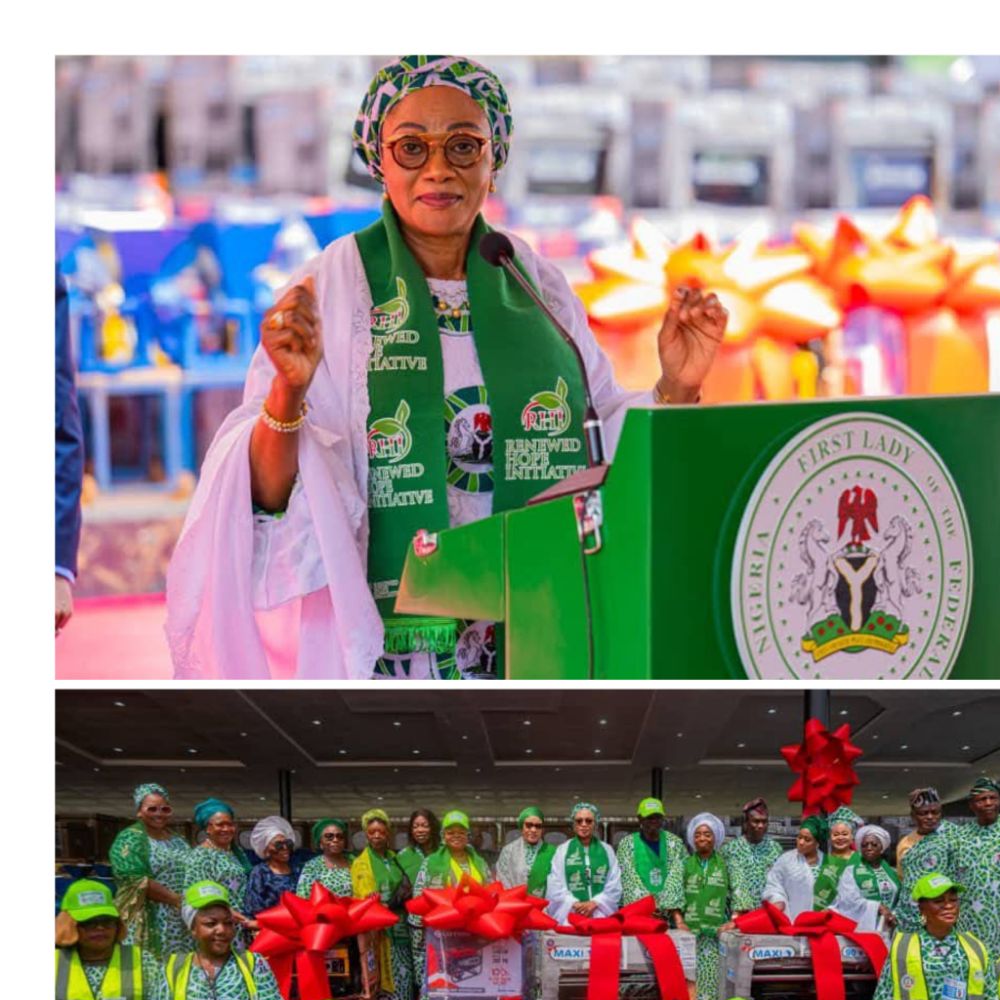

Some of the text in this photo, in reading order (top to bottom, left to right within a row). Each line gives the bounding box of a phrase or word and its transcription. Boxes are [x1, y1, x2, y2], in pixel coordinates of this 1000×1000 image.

[505, 438, 581, 452] RENEWED
[797, 430, 915, 474] FIRST LADY
[505, 451, 549, 466] HOPE
[926, 475, 940, 494] OF
[749, 531, 770, 654] NIGERIA
[553, 949, 584, 958] MAXI
[752, 950, 782, 958] MAXI
